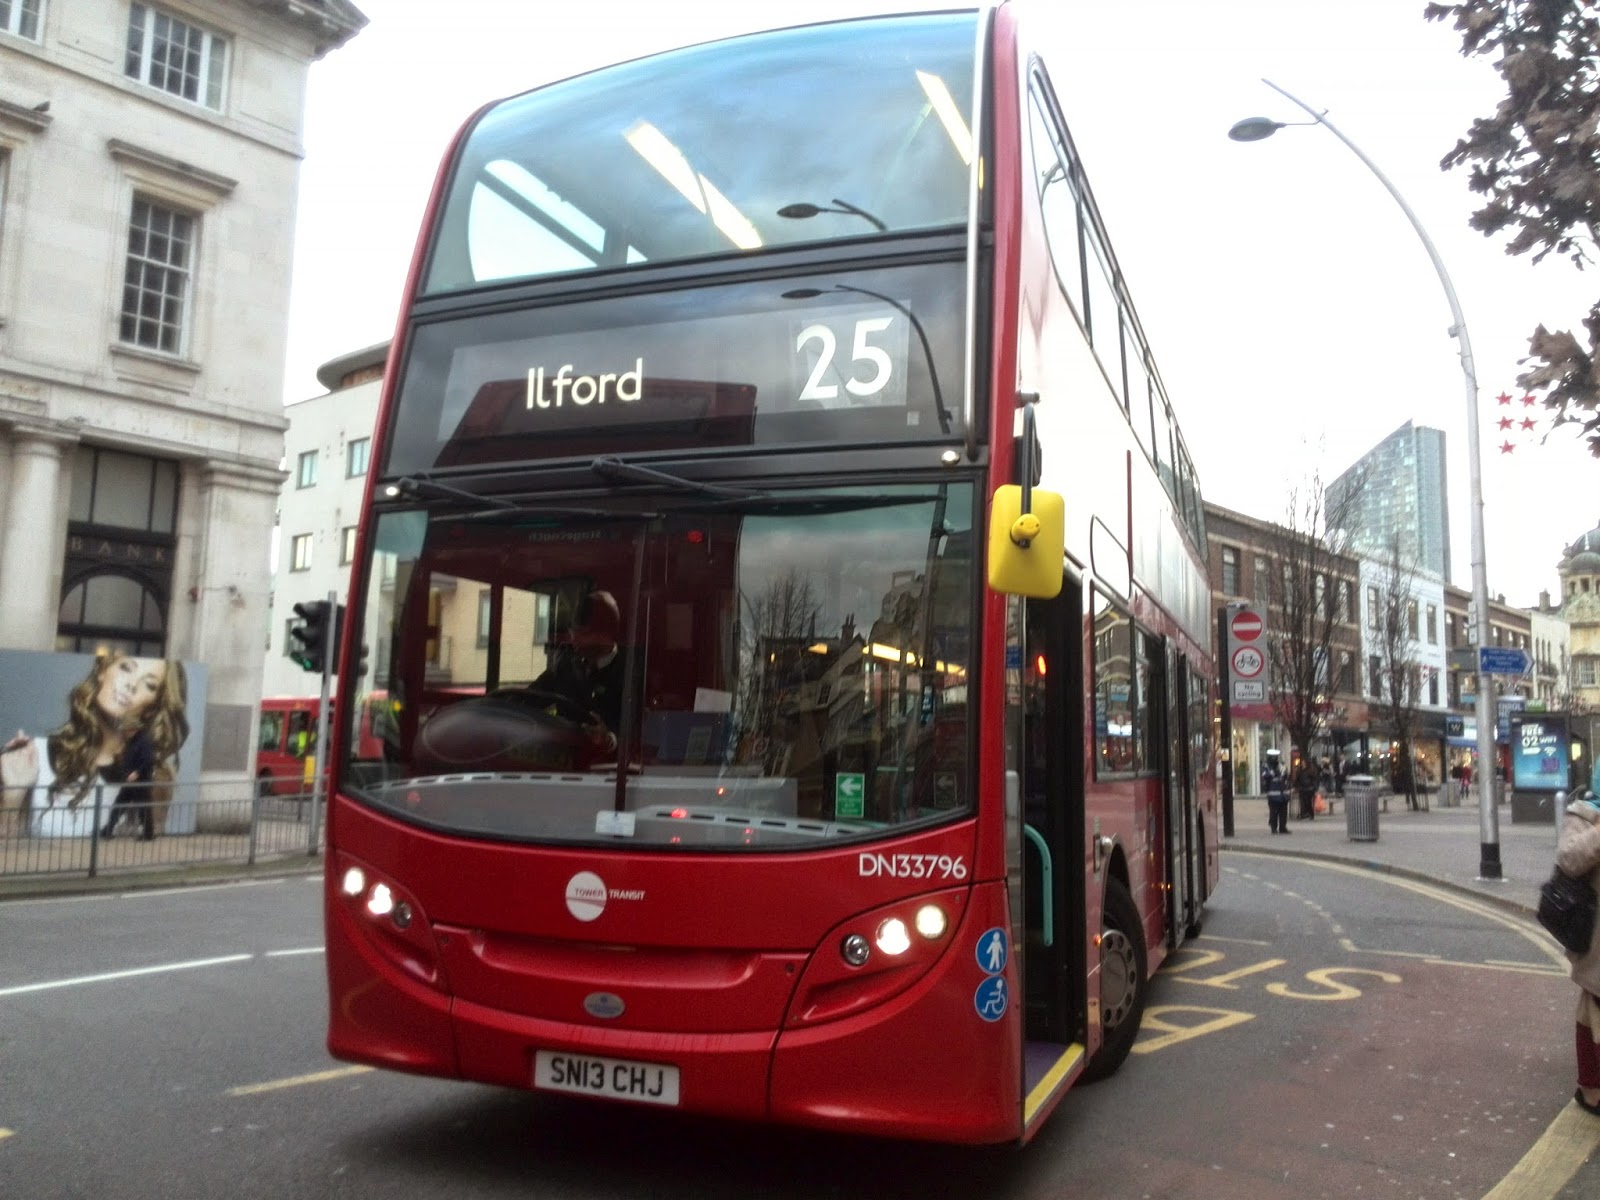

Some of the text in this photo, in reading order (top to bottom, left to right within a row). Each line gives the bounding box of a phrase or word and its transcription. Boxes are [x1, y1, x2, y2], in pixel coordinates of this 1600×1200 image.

[796, 316, 894, 401] 25
[526, 357, 644, 409] Ilford
[71, 536, 166, 562] BANK
[859, 853, 968, 880] DN33796
[575, 887, 646, 901] TOWER TRANSIT
[550, 1056, 664, 1098] SN13 CHJ
